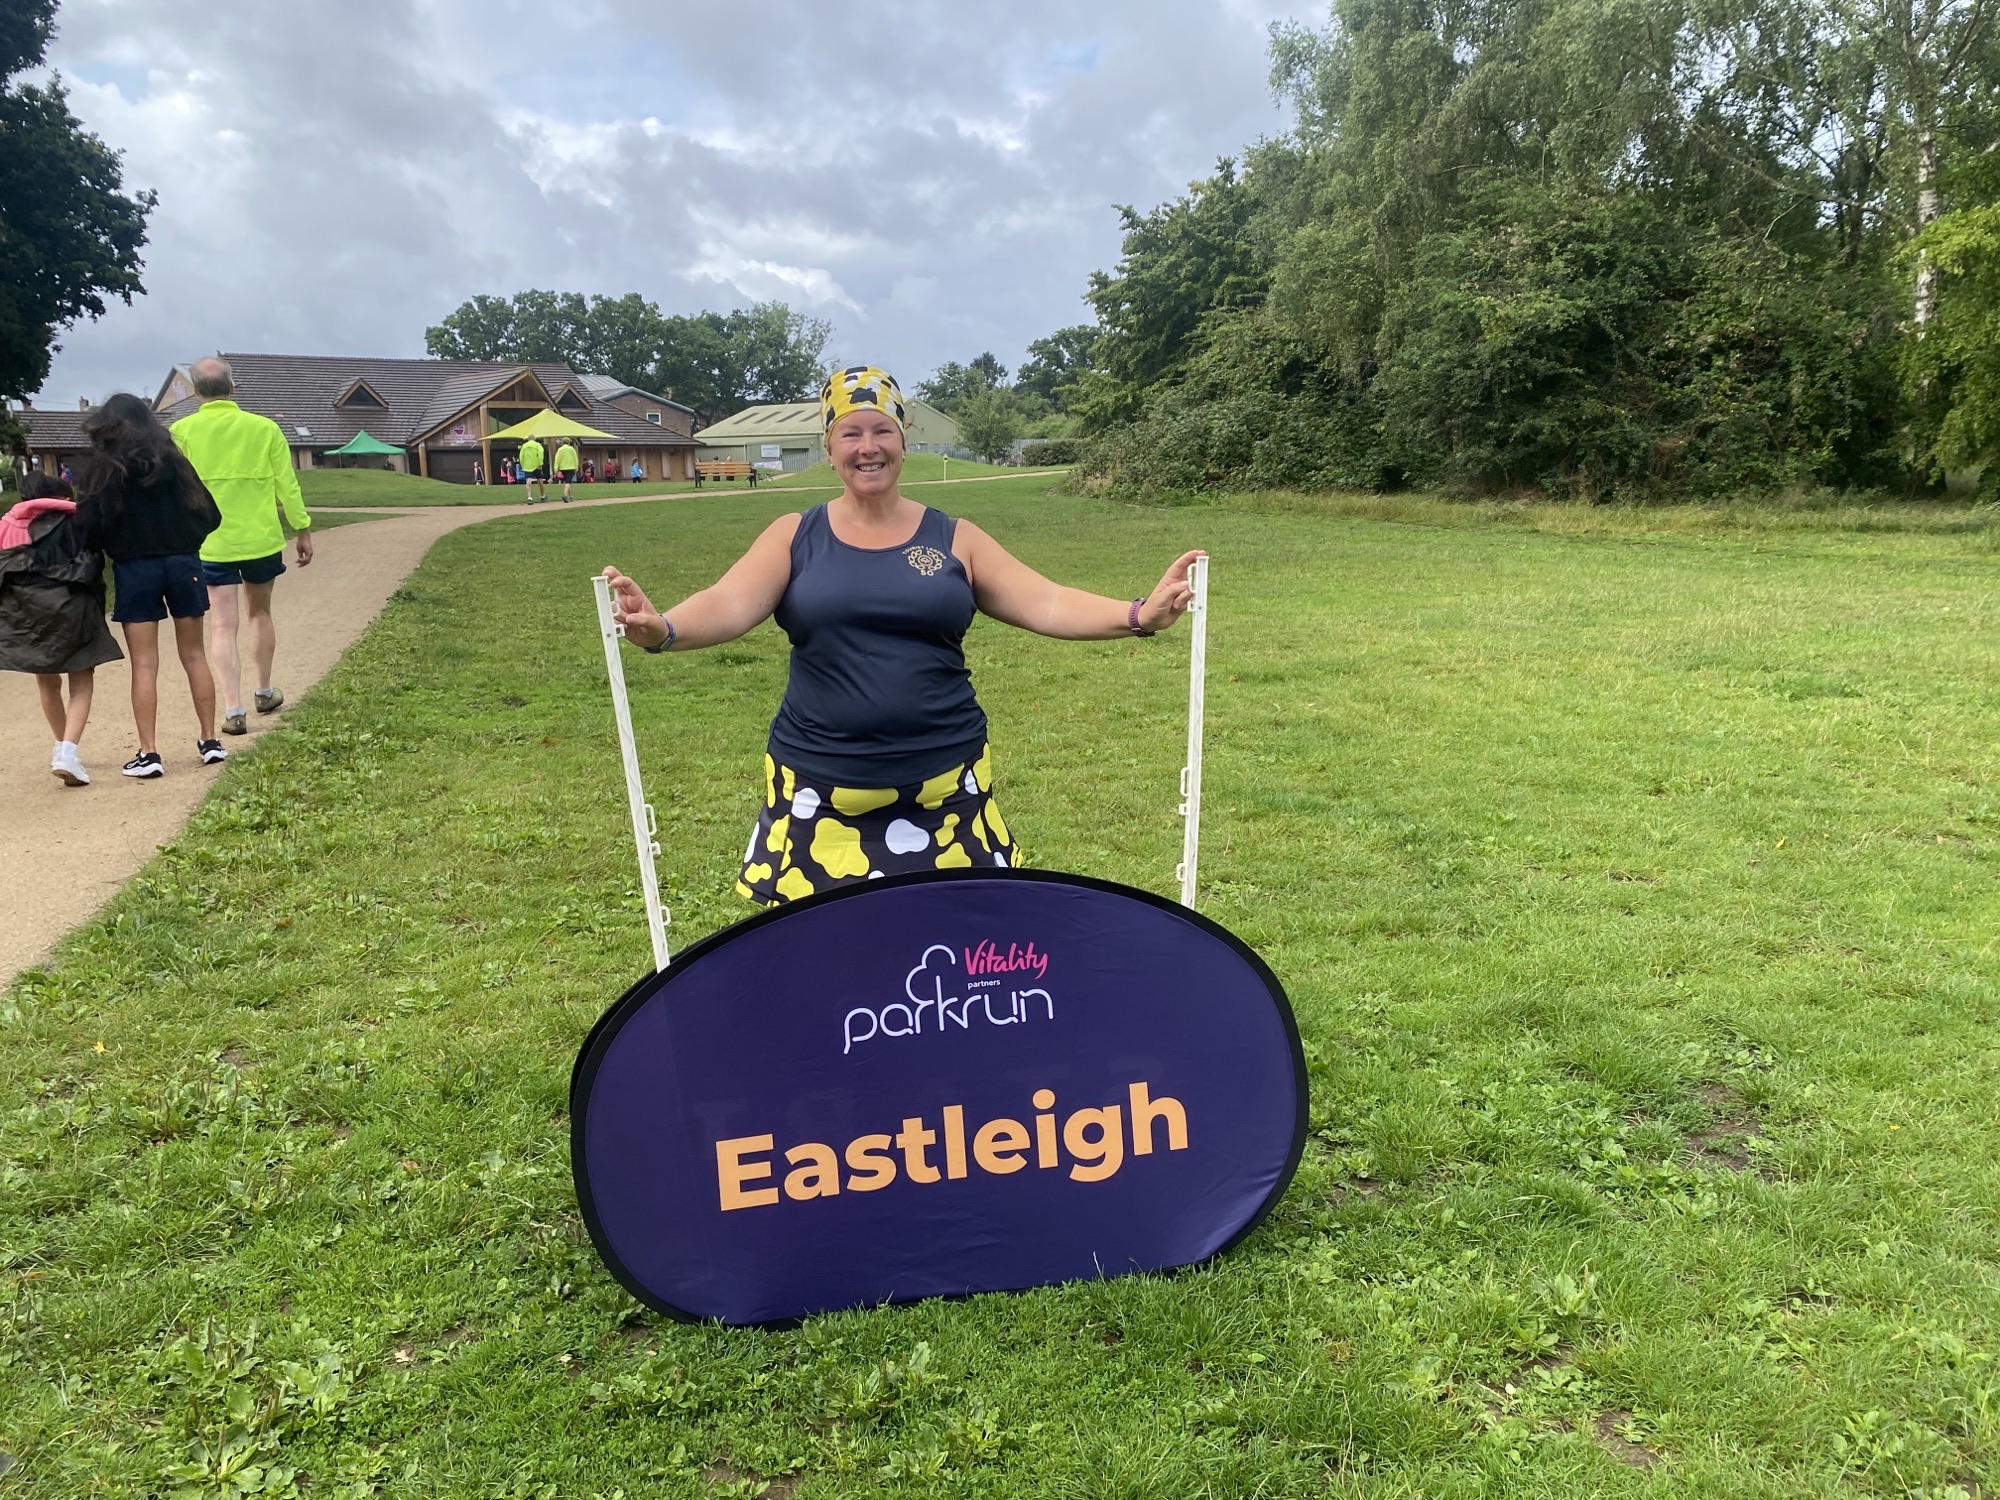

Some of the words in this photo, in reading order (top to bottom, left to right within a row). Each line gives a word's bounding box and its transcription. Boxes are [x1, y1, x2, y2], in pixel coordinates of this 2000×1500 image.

[964, 938, 1048, 980] Vitality
[967, 978, 1001, 990] partners
[843, 944, 1054, 1055] parkrun
[715, 1081, 1190, 1212] Eastleigh
